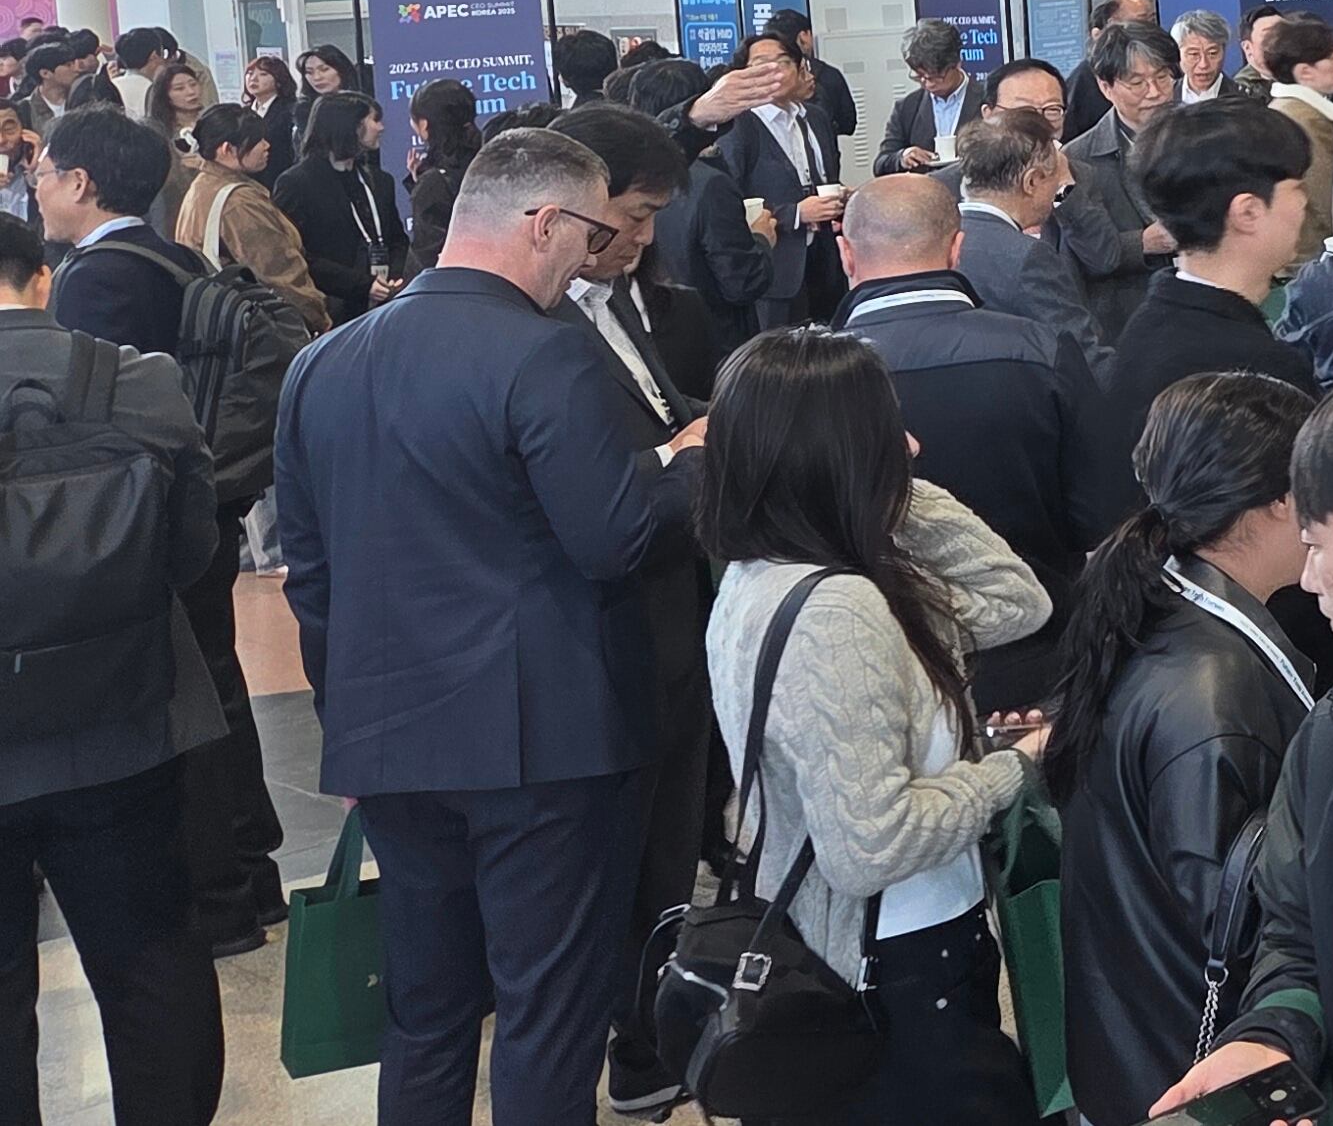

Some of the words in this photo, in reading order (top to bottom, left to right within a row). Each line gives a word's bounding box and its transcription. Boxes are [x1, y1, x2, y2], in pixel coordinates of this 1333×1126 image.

[423, 3, 469, 20] APEC
[471, 9, 497, 17] KOREA
[969, 28, 998, 45] Tech
[960, 46, 985, 61] rum
[389, 62, 419, 75] 2025
[420, 59, 454, 72] APEC
[455, 57, 481, 70] CEO
[483, 54, 535, 67] SUMMIT,
[478, 70, 537, 94] Tech
